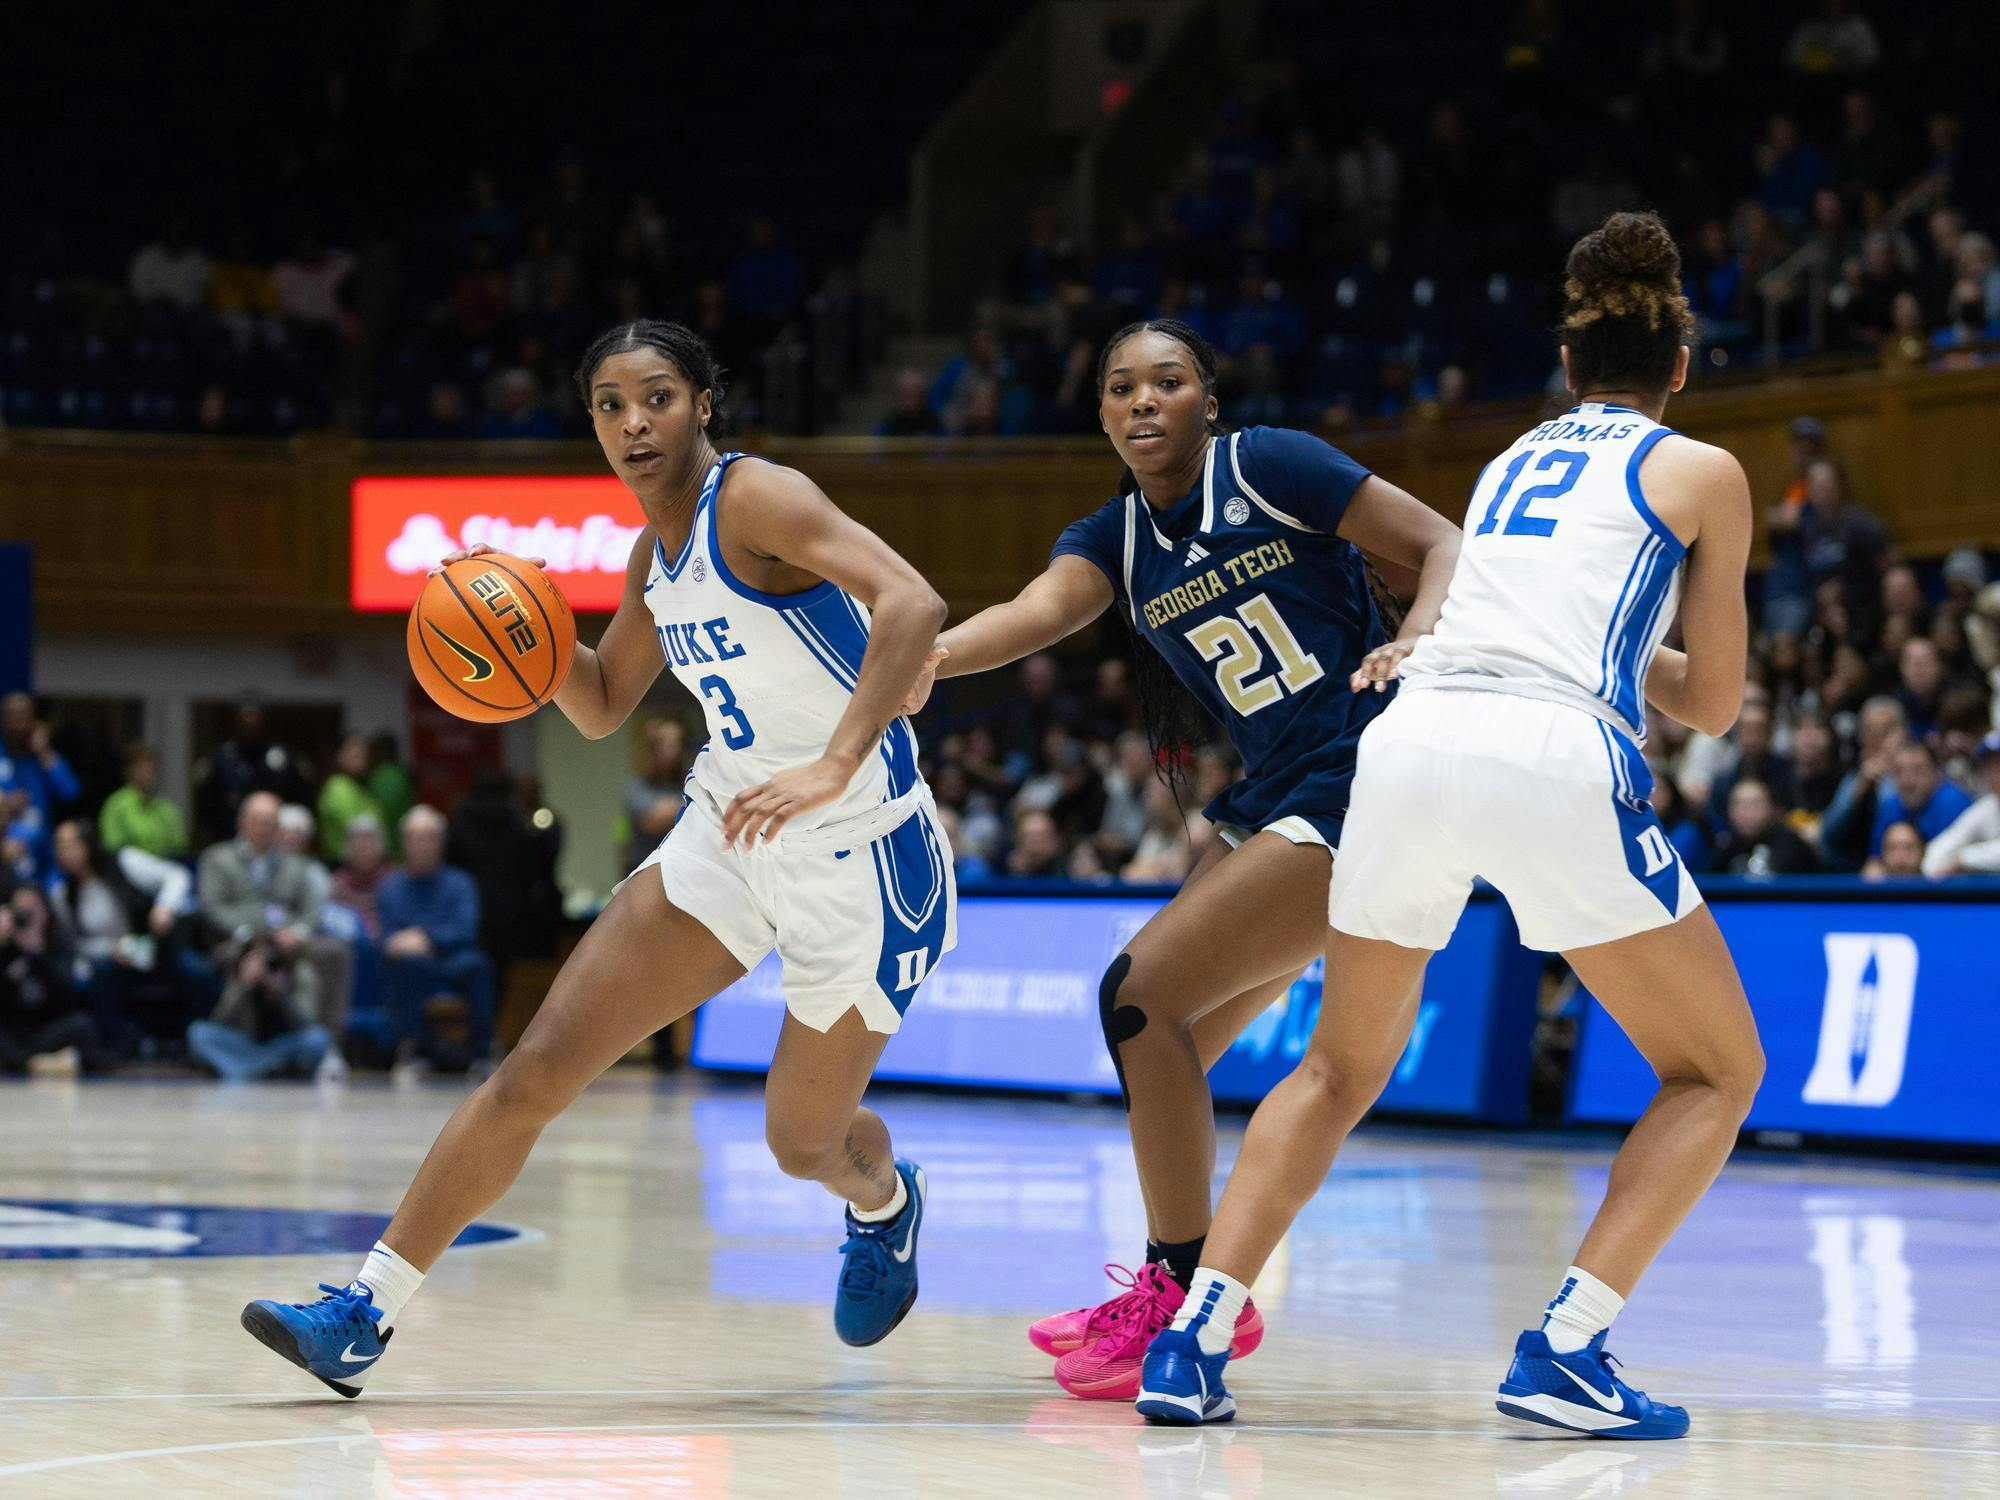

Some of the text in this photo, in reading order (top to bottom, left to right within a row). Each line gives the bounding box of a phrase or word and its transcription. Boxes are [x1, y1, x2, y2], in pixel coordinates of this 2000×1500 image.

[1475, 449, 1590, 537] 12
[467, 571, 539, 657] ELITE
[1143, 538, 1295, 630] GEORGIA TECH
[1184, 592, 1326, 718] 21
[699, 673, 755, 751] 3
